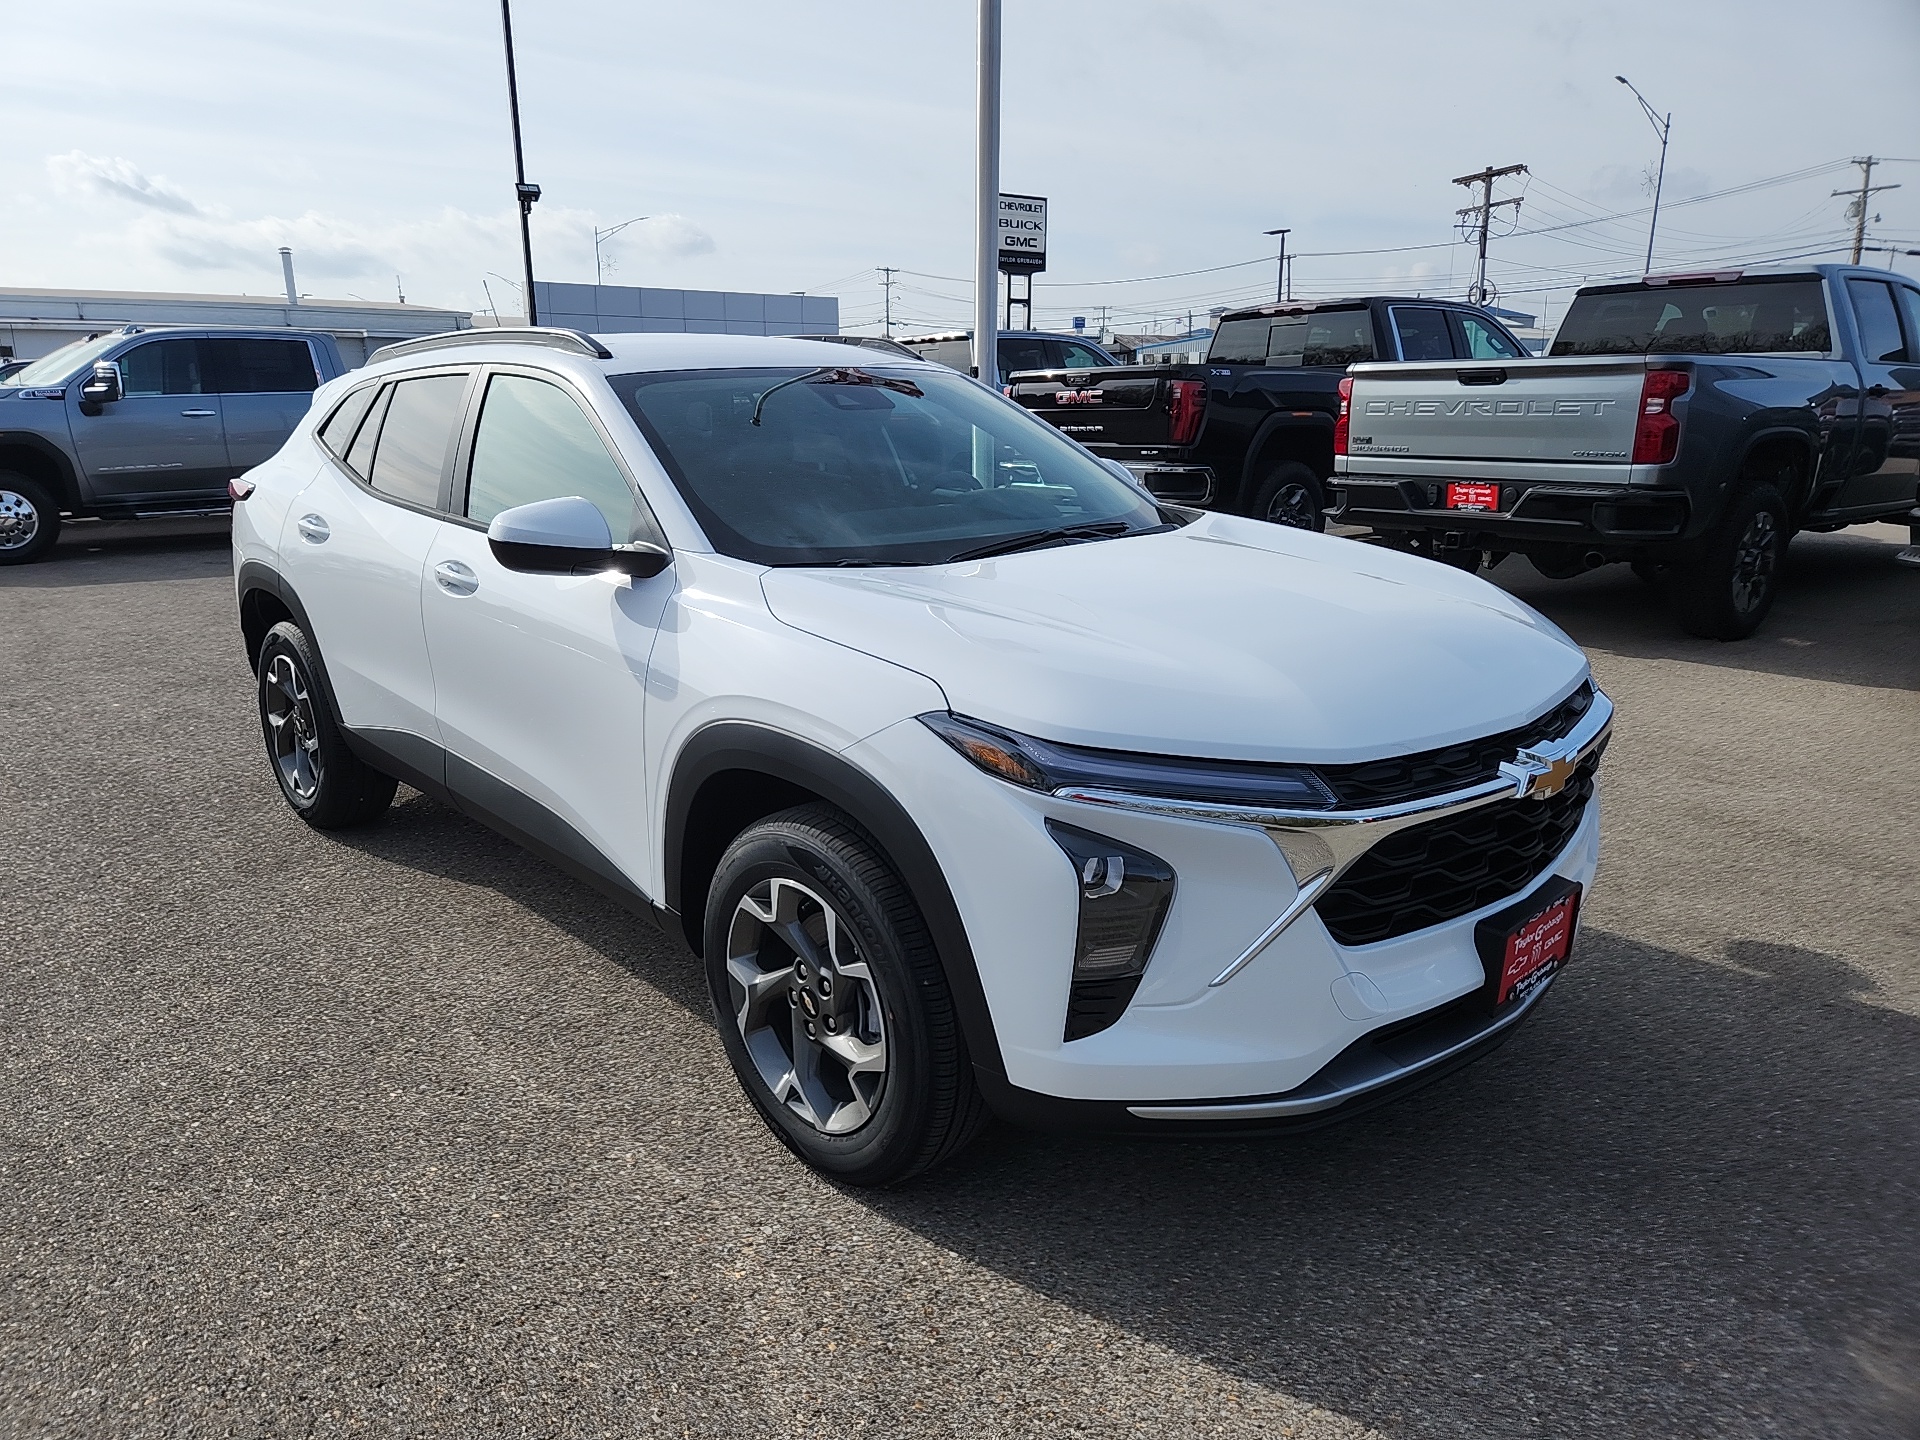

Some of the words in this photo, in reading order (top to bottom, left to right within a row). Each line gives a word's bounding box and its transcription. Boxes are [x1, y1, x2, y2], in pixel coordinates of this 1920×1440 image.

[999, 201, 1043, 213] CHEVROLET
[999, 218, 1043, 231] BUICK
[1004, 235, 1038, 248] GMC
[1055, 389, 1104, 405] GMC
[1365, 399, 1616, 417] CHEVROLET
[1543, 929, 1564, 950] GMC
